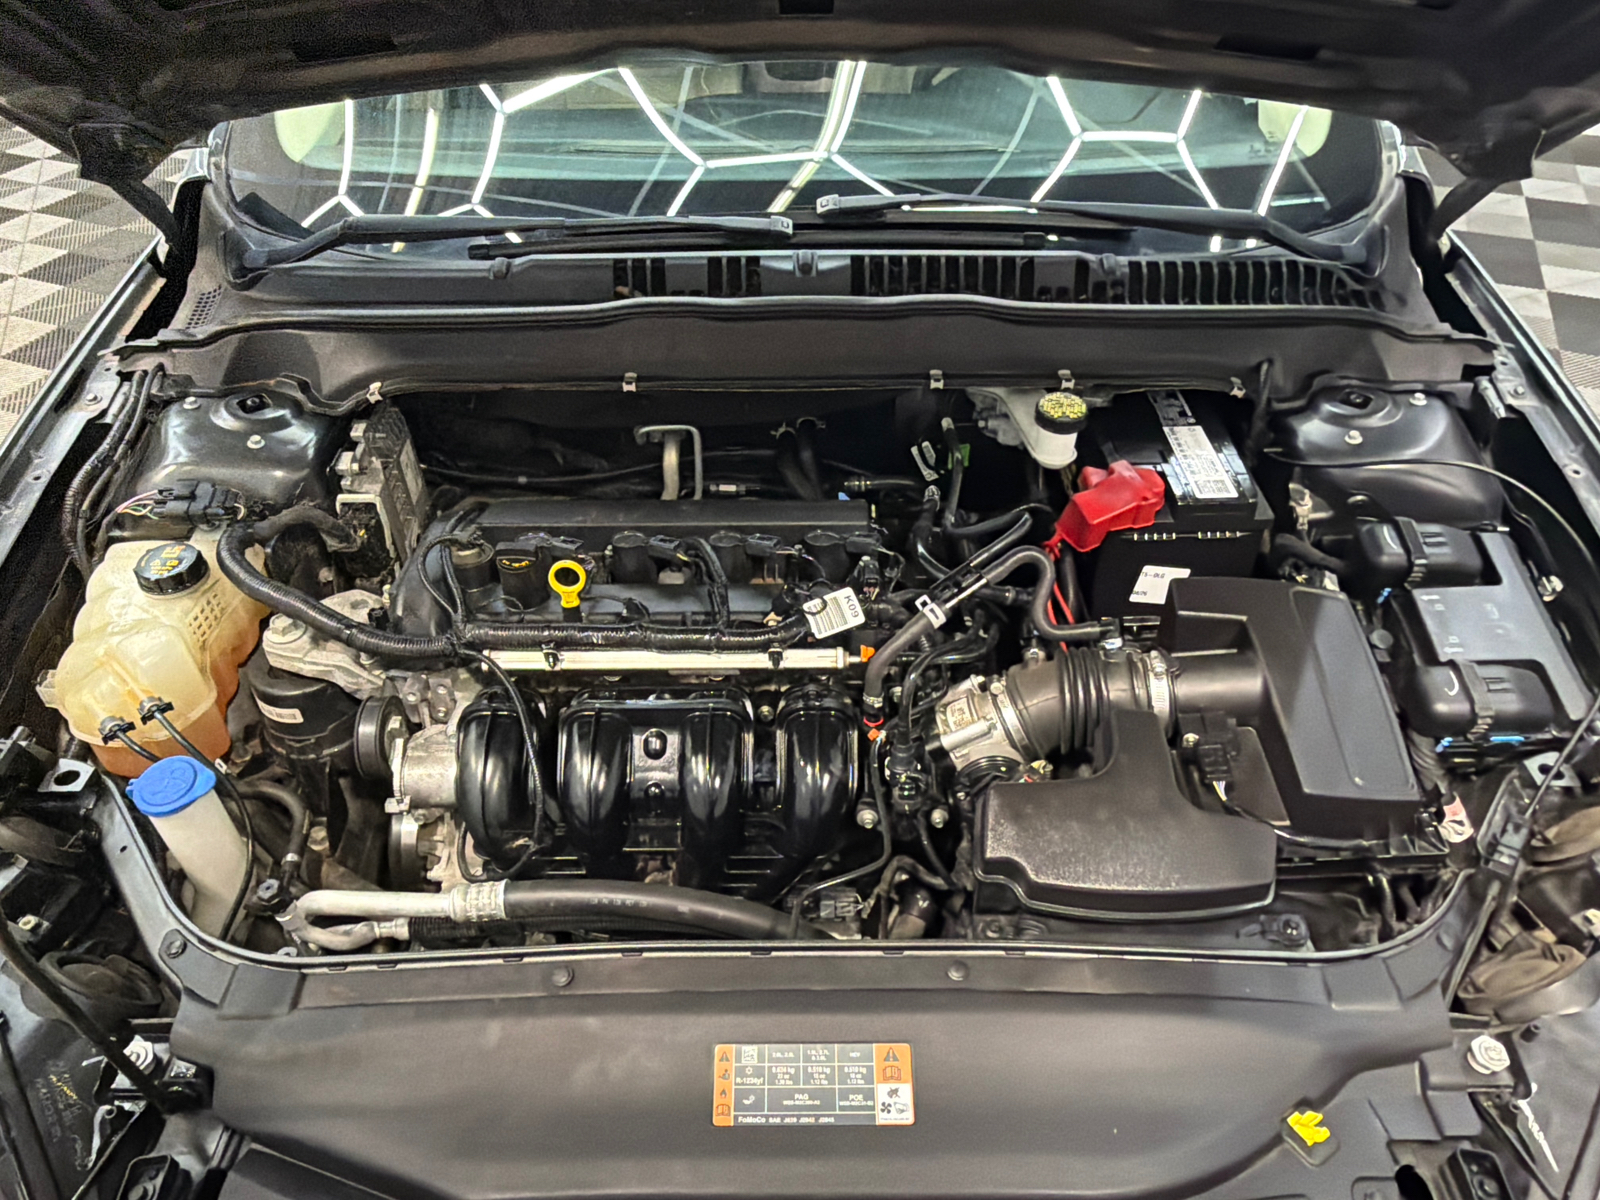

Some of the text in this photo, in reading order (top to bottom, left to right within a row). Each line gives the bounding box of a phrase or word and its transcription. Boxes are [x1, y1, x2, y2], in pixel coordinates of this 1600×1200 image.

[844, 595, 860, 618] K09
[787, 1066, 796, 1075] kg
[823, 1066, 831, 1075] kg
[859, 1066, 867, 1074] kg
[735, 1077, 764, 1085] R-1234yf
